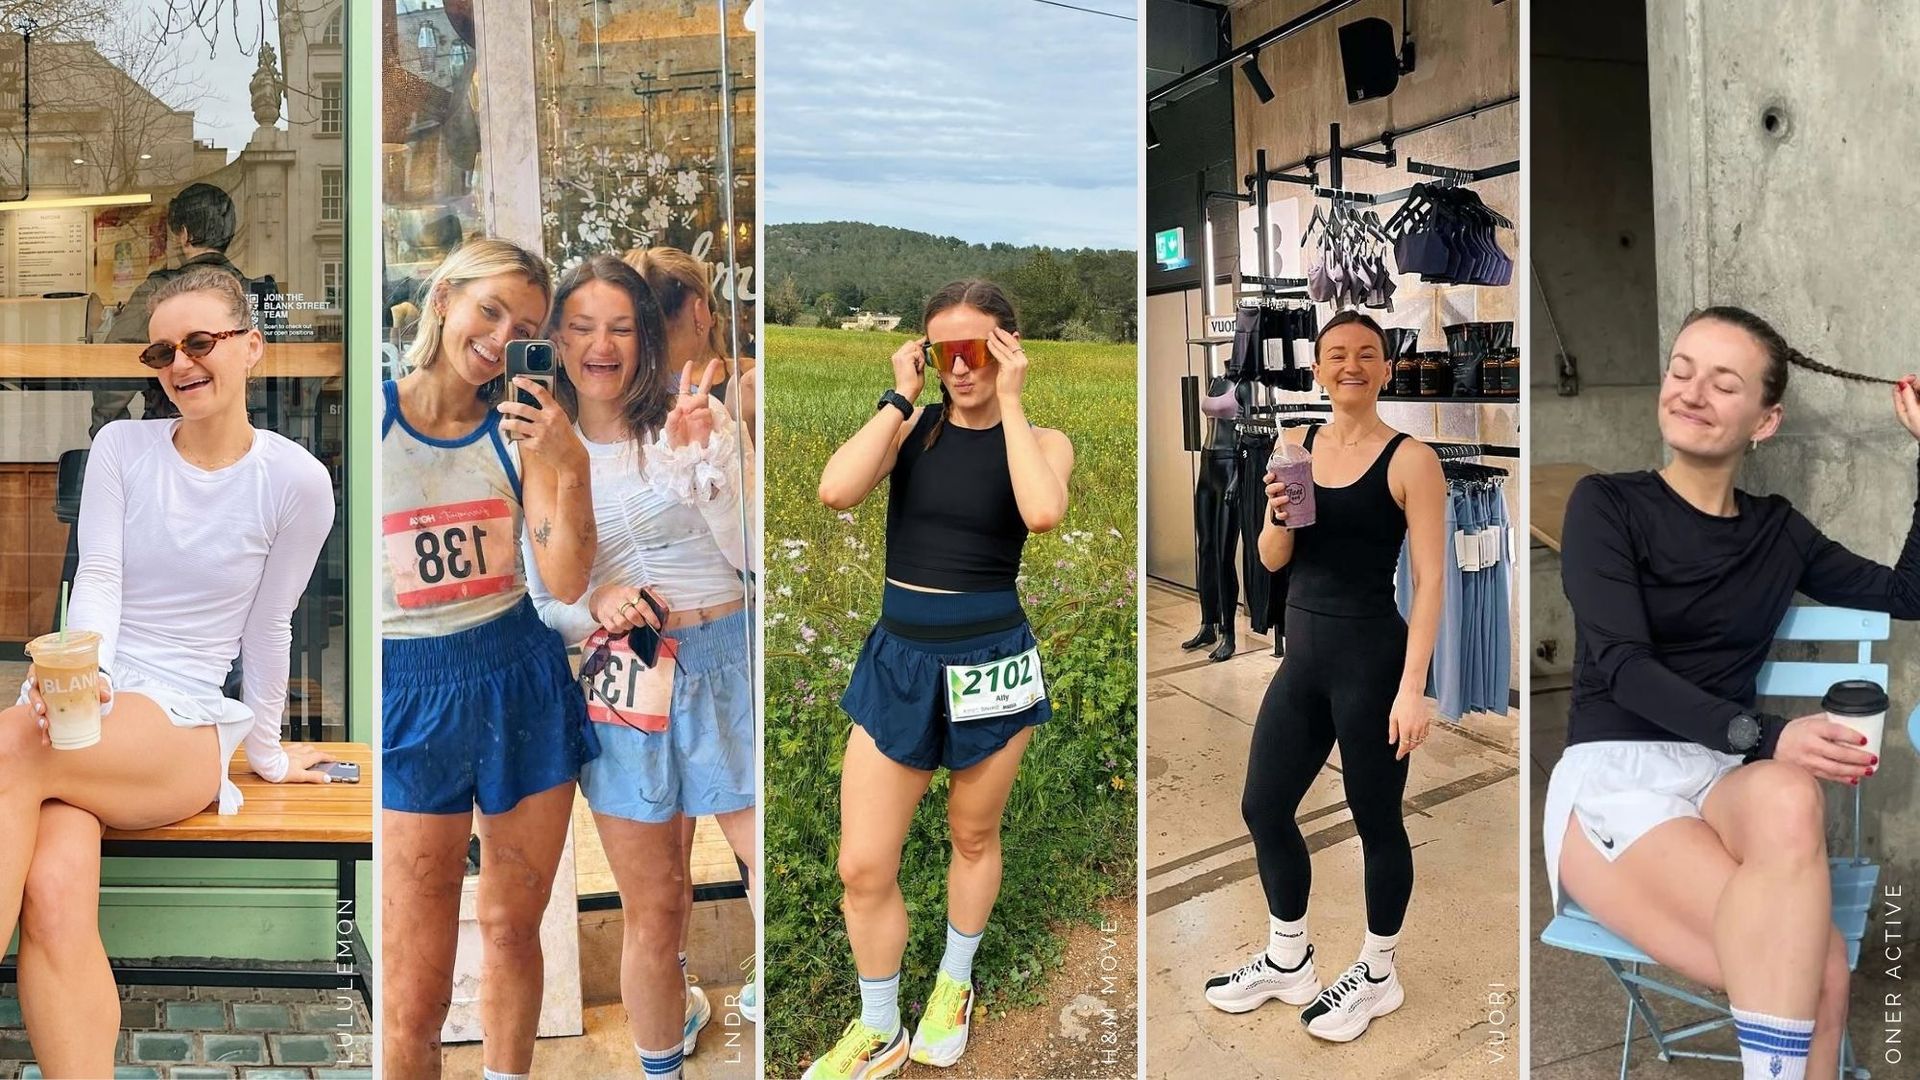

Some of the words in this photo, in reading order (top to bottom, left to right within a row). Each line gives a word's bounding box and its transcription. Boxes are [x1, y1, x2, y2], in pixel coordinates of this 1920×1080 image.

[263, 293, 284, 302] JOIN
[286, 293, 304, 302] THE
[263, 301, 294, 310] BLANK
[296, 301, 331, 310] STREET
[263, 310, 288, 319] TEAM
[962, 655, 1033, 696] 2102
[996, 694, 1010, 702] Ally
